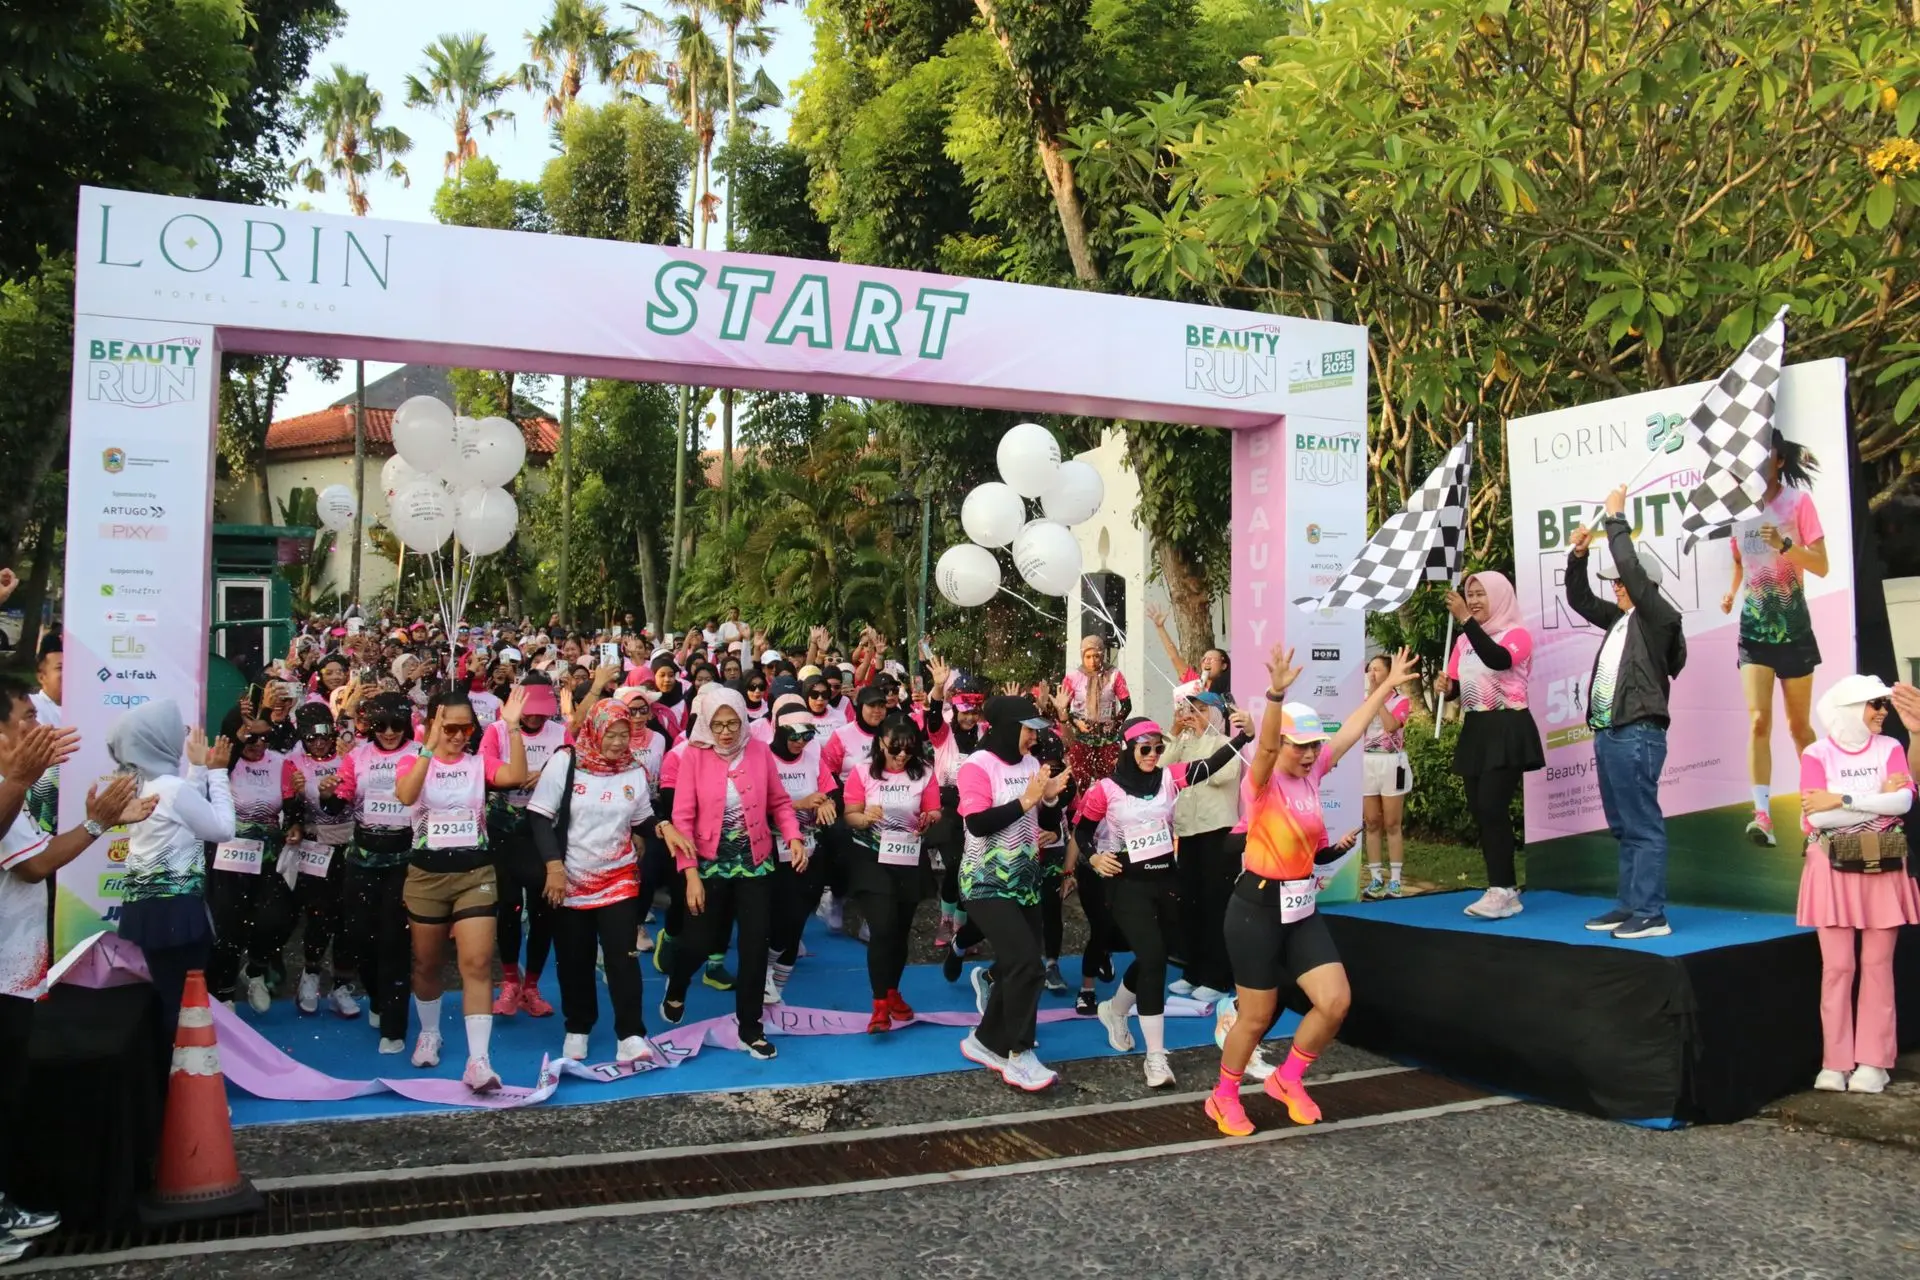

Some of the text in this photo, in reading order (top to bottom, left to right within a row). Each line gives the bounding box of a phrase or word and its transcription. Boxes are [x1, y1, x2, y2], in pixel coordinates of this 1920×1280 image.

[97, 204, 392, 290] LORIN
[154, 289, 336, 312] HOTEL SOLO
[645, 259, 970, 360] START
[1264, 324, 1280, 334] FUN
[182, 337, 201, 346] FUN
[1186, 324, 1280, 355] BEAUTY
[90, 339, 200, 366] BEAUTY
[1323, 351, 1353, 363] 21 DEC
[1185, 347, 1277, 395] RUN
[1323, 360, 1353, 374] 2025
[87, 360, 196, 404] RUN
[1295, 433, 1360, 453] BEAUTY
[1533, 421, 1627, 464] LORIN
[1295, 450, 1359, 483] RUN
[1669, 469, 1703, 489] FUN
[103, 506, 148, 516] ARTUGO
[1310, 563, 1335, 571] ARTUGO
[111, 635, 145, 654] Ella
[1313, 650, 1338, 658] NONA
[436, 770, 468, 779] BEAUTY
[1546, 762, 1588, 781] Beauty
[1668, 757, 1721, 775] Documentation
[1840, 767, 1879, 777] BEAUTY
[370, 802, 405, 814] 29117
[432, 822, 474, 835] 29349
[887, 843, 916, 854] 29116
[1130, 831, 1168, 850] 29248
[223, 849, 257, 862] 29118
